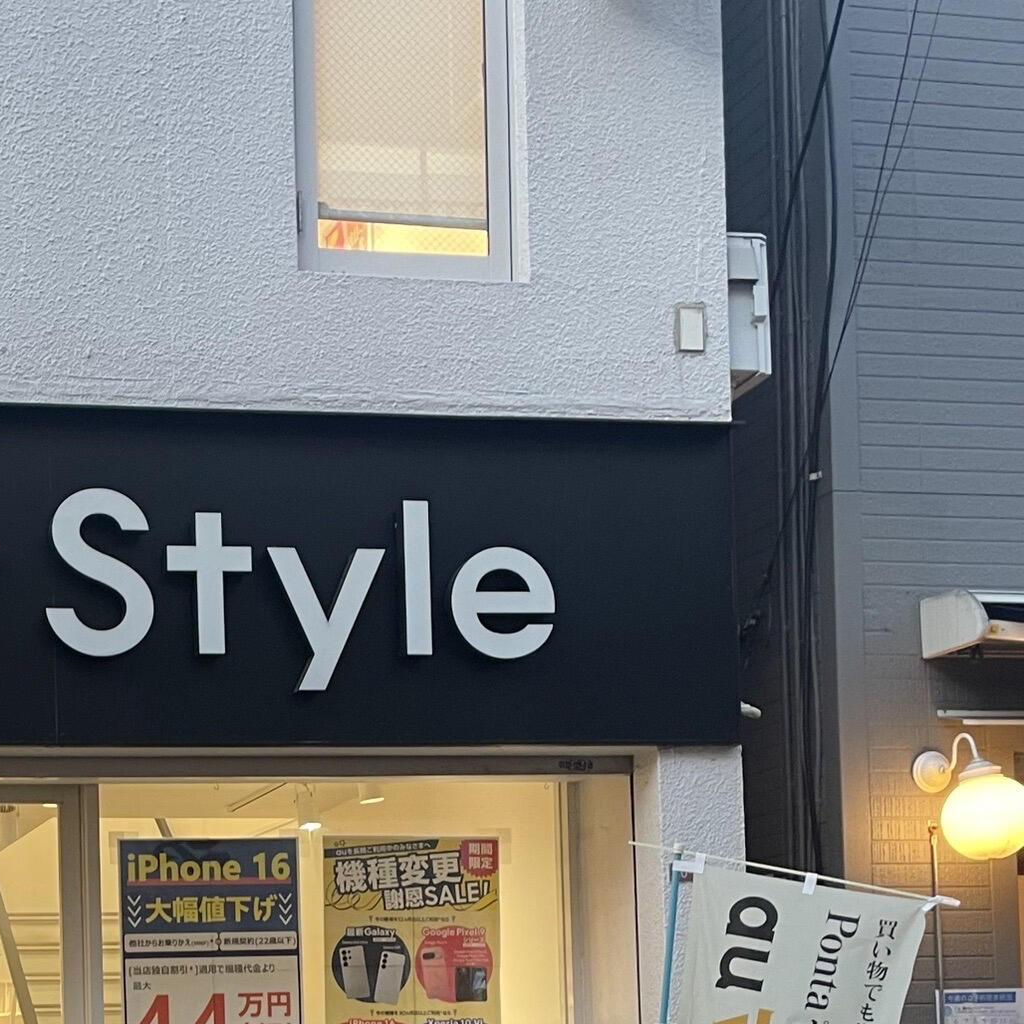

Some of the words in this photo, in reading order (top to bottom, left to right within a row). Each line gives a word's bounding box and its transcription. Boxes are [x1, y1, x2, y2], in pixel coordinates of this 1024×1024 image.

[46, 487, 556, 692] Style
[468, 842, 493, 855] 期間
[468, 857, 493, 870] 限定
[127, 852, 242, 882] iPhone
[252, 851, 291, 881] 16
[335, 852, 462, 893] 機種変更
[145, 894, 278, 924] 大幅値下げ
[237, 991, 292, 1018] 万円
